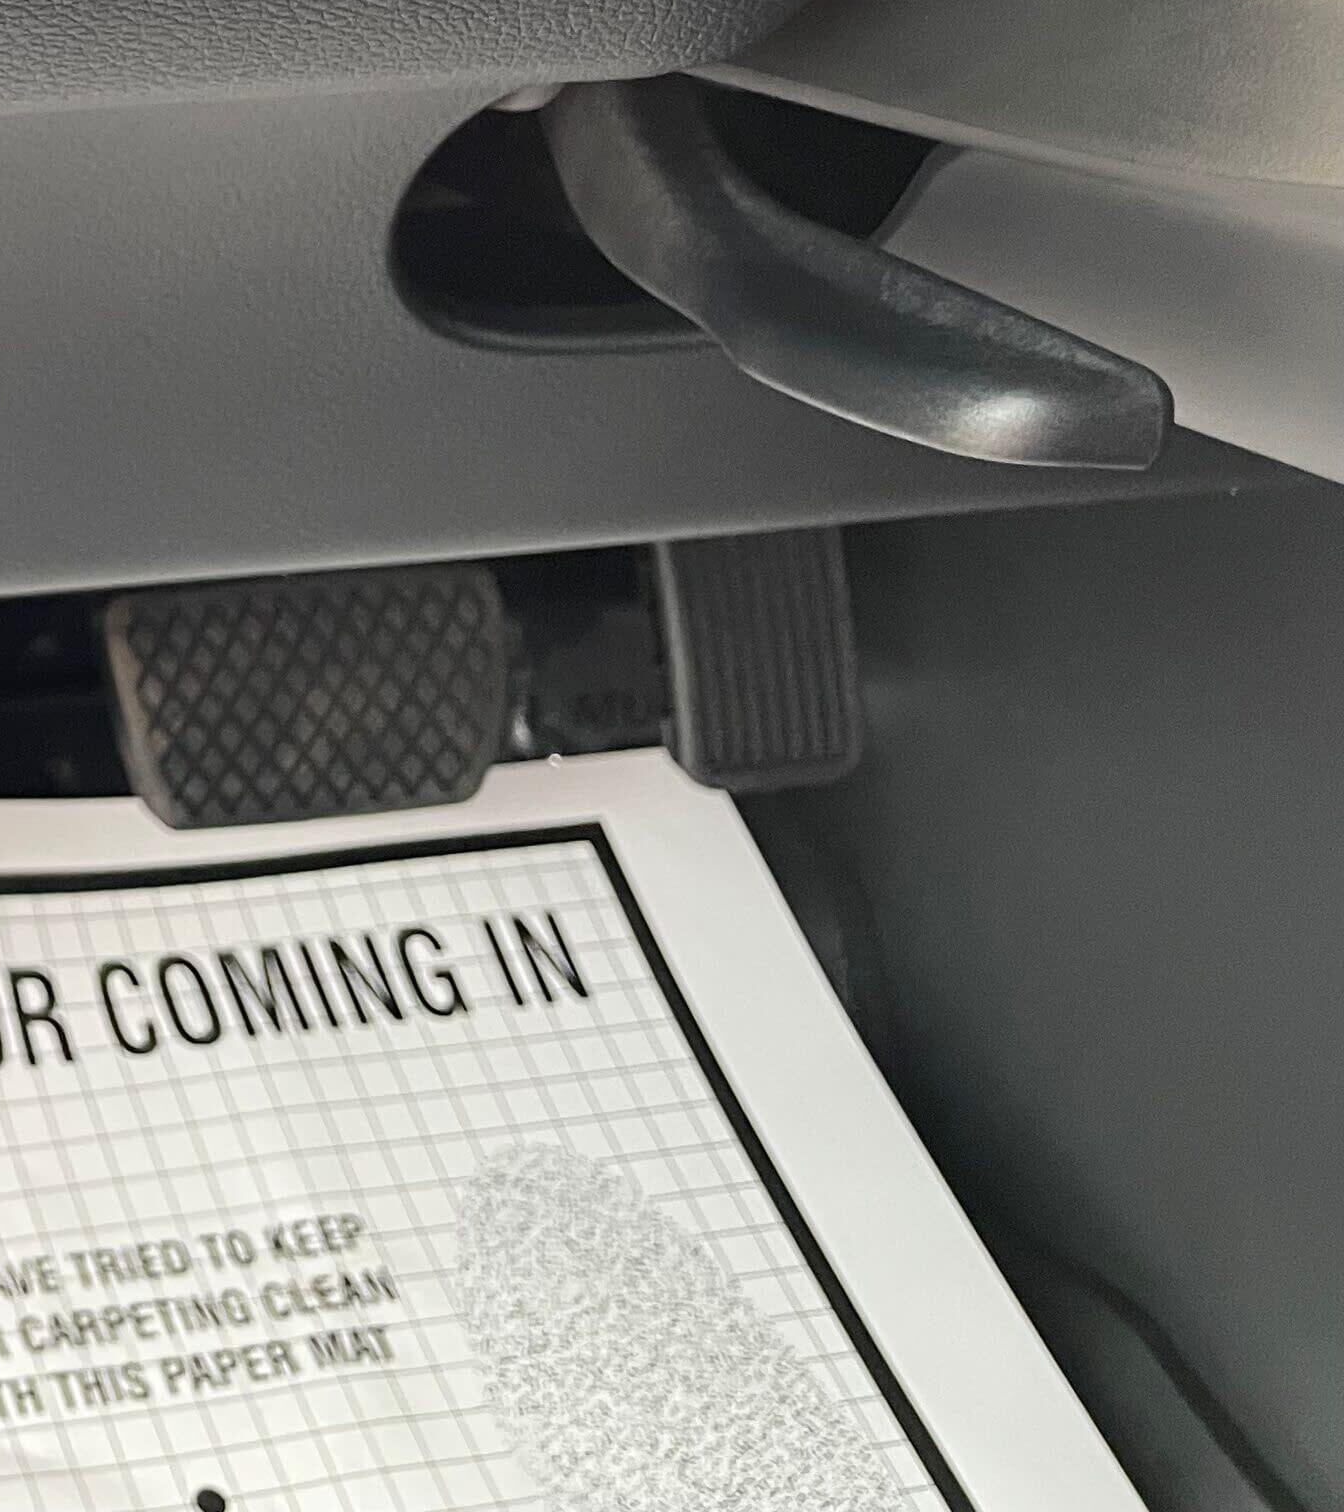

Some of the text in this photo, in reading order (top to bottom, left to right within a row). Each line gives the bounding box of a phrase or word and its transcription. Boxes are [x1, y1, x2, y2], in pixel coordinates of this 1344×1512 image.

[97, 925, 469, 1055] COMING
[483, 909, 590, 1006] IN
[68, 1238, 193, 1290] TRIED
[200, 1228, 257, 1269] TO
[263, 1212, 364, 1263] KEEP
[18, 1286, 254, 1355] CARPETING
[260, 1264, 400, 1322] CLEAN
[47, 1360, 150, 1410] THIS
[161, 1339, 301, 1396] PAPER
[307, 1323, 396, 1371] MAT
